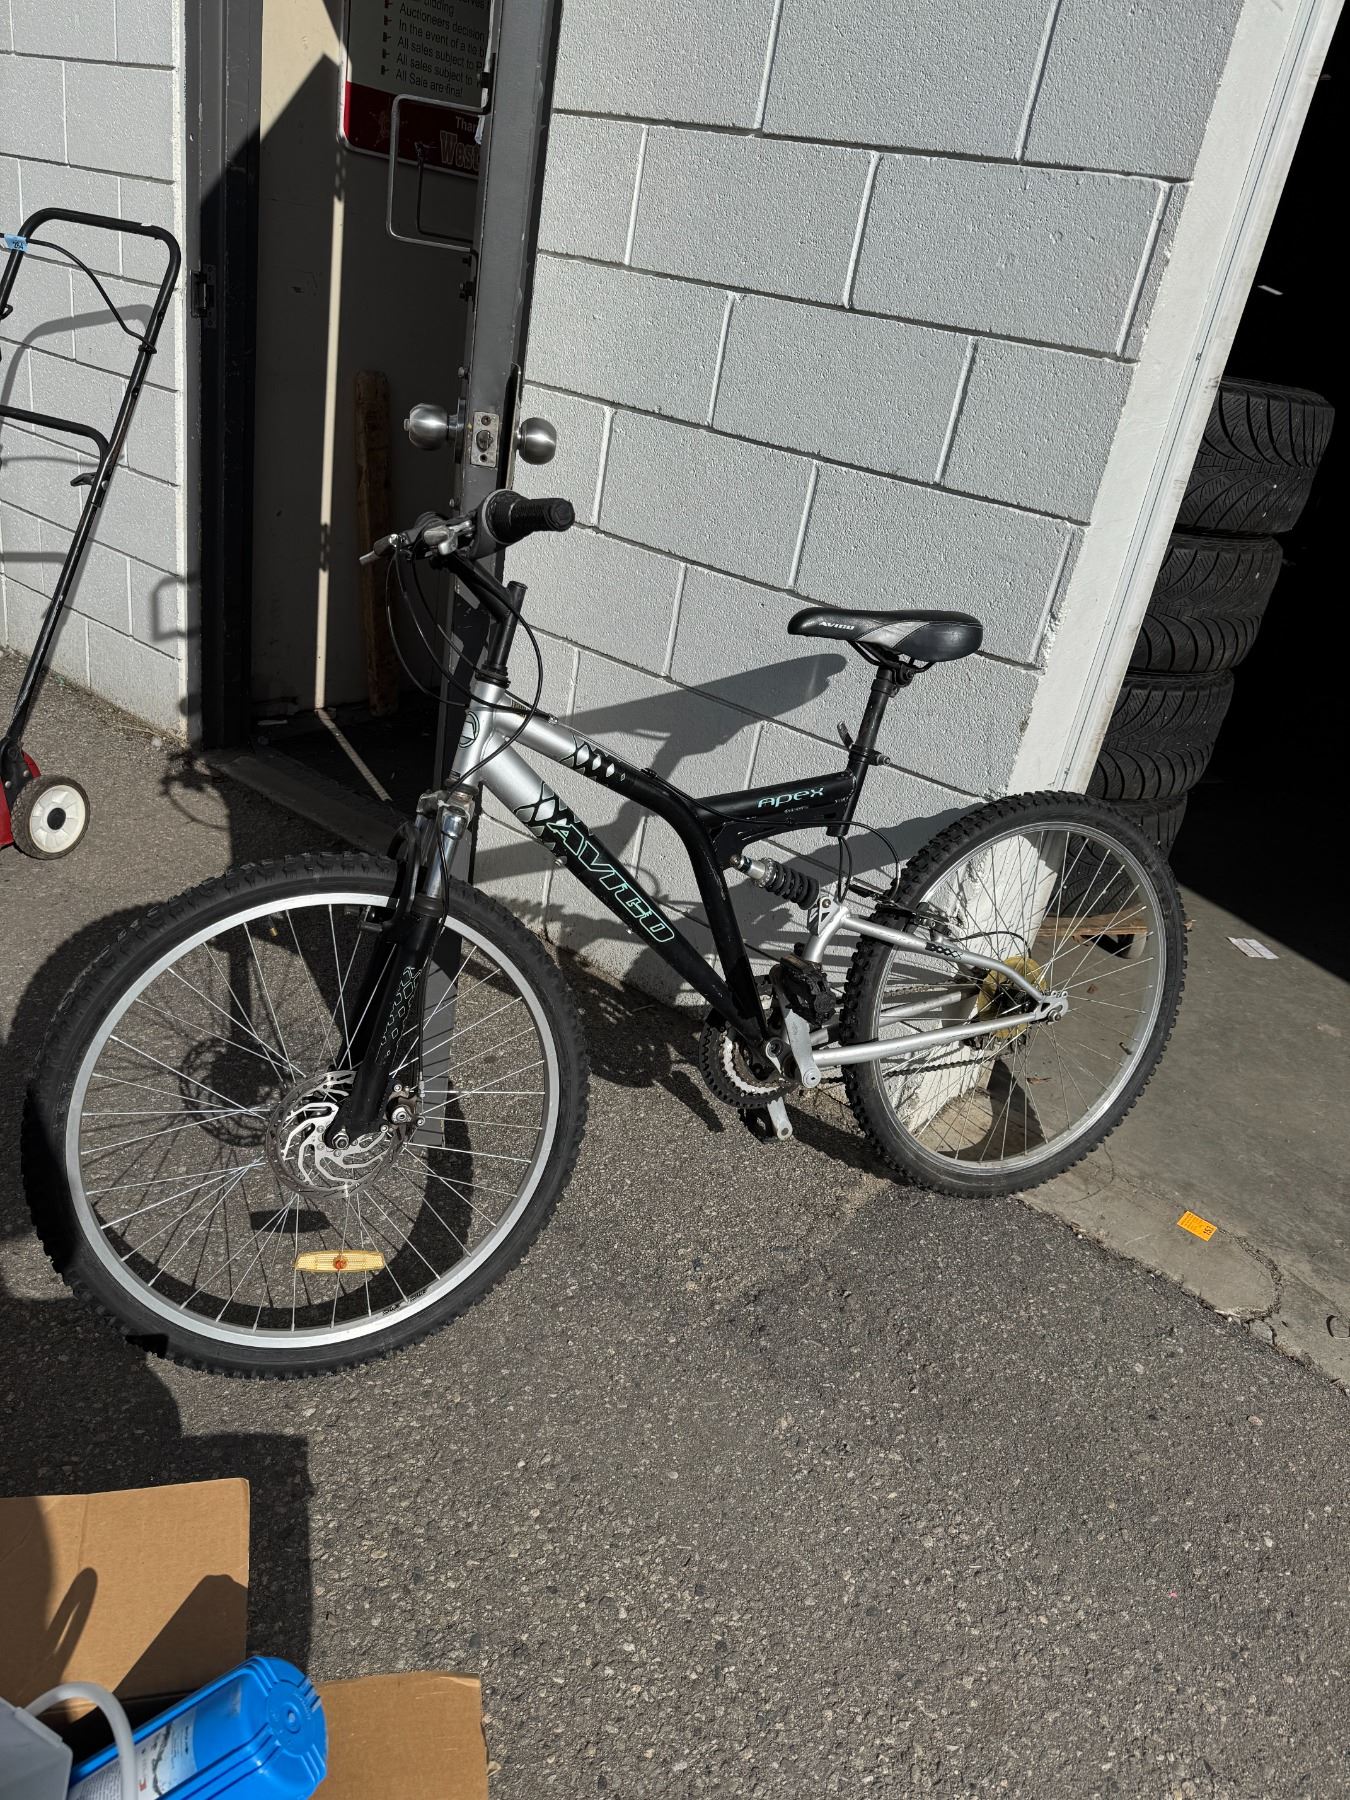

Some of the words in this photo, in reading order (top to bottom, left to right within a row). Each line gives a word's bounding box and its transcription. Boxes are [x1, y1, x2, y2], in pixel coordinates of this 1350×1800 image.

[399, 19, 407, 33] In
[409, 23, 423, 37] the
[426, 31, 449, 46] event
[450, 39, 459, 49] of
[460, 42, 466, 51] a
[400, 3, 450, 29] Auctioneers
[452, 22, 485, 42] decision
[398, 36, 408, 49] All
[411, 41, 433, 57] sales
[435, 50, 465, 67] subject
[466, 58, 475, 69] to
[396, 69, 406, 82] All
[409, 73, 428, 88] Sale
[430, 81, 444, 93] are
[446, 83, 463, 97] final
[397, 53, 407, 66] All
[410, 58, 433, 73] sales
[434, 66, 464, 83] subject
[465, 75, 473, 86] to
